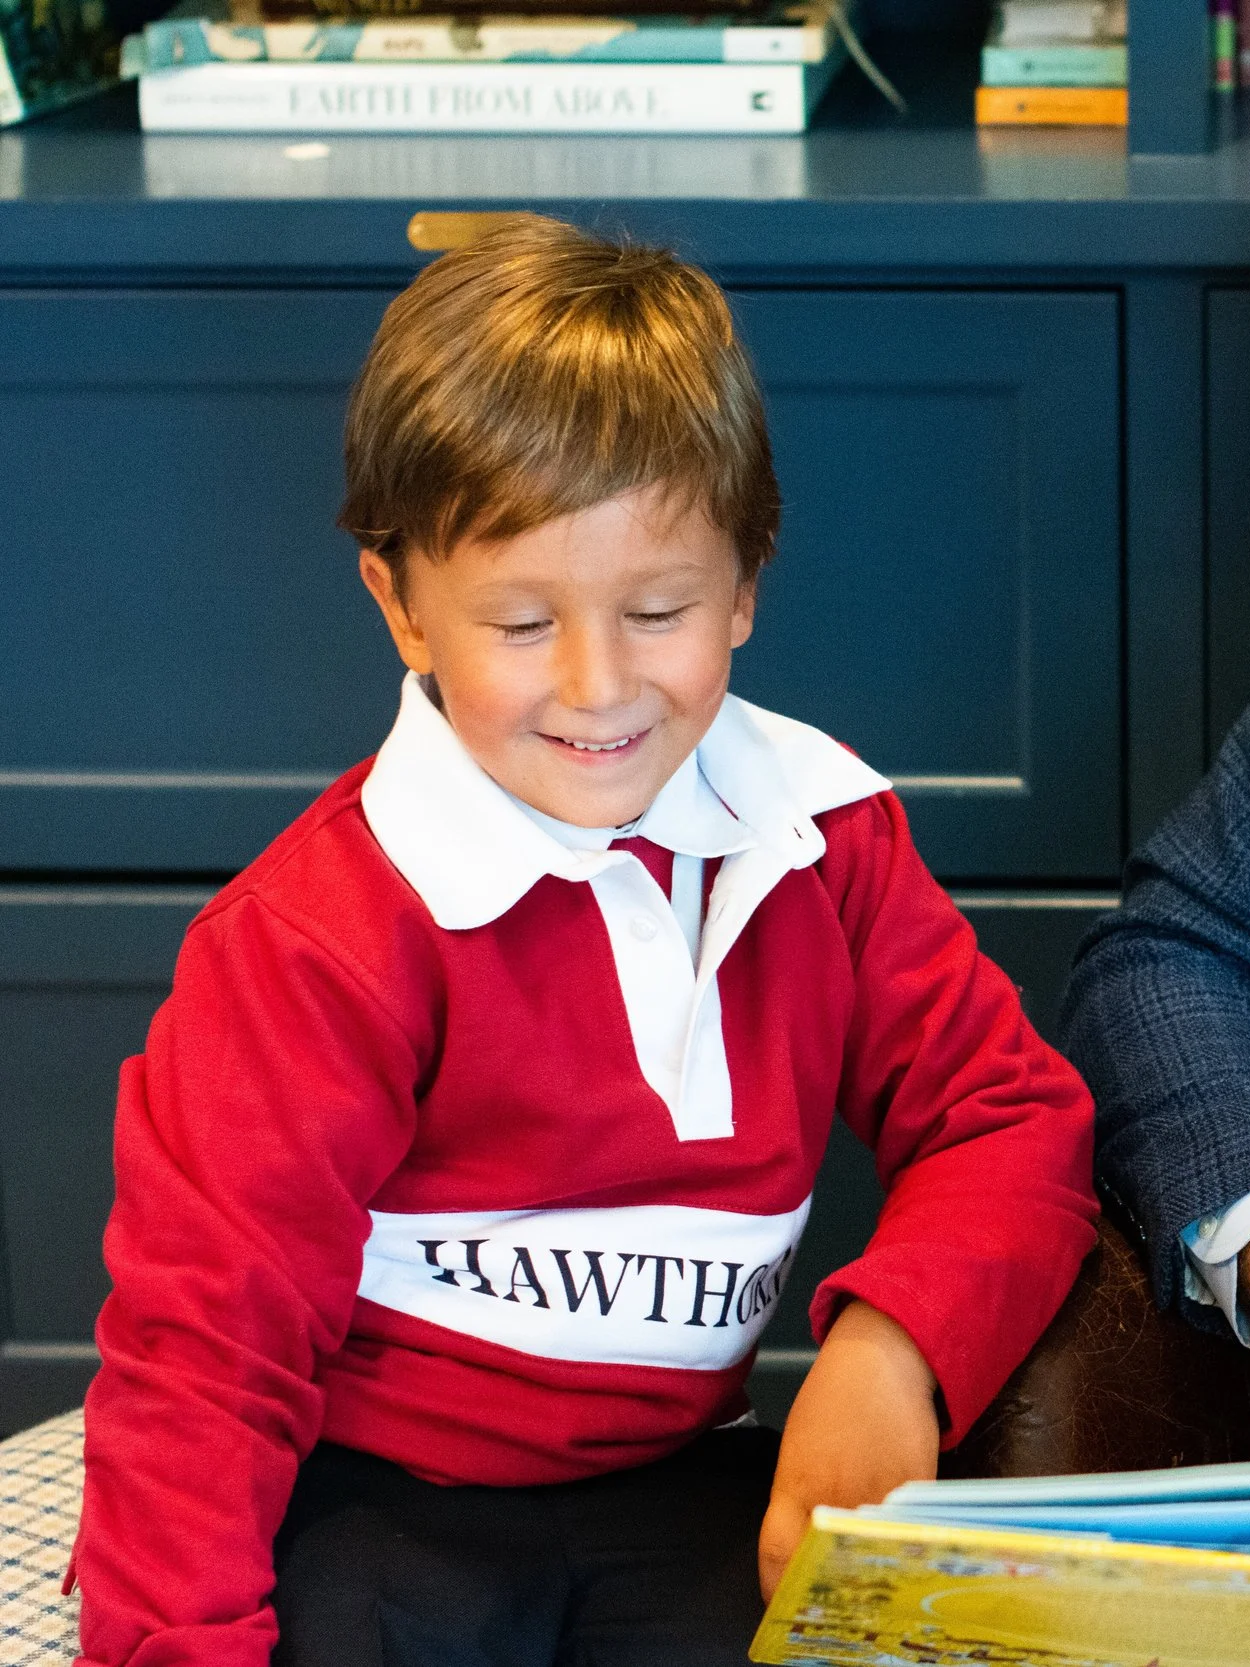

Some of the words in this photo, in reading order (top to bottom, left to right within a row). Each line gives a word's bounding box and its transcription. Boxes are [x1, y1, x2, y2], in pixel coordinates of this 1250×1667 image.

[288, 84, 413, 115] EARTH
[427, 84, 533, 115] FROM
[551, 84, 666, 116] ABOVE
